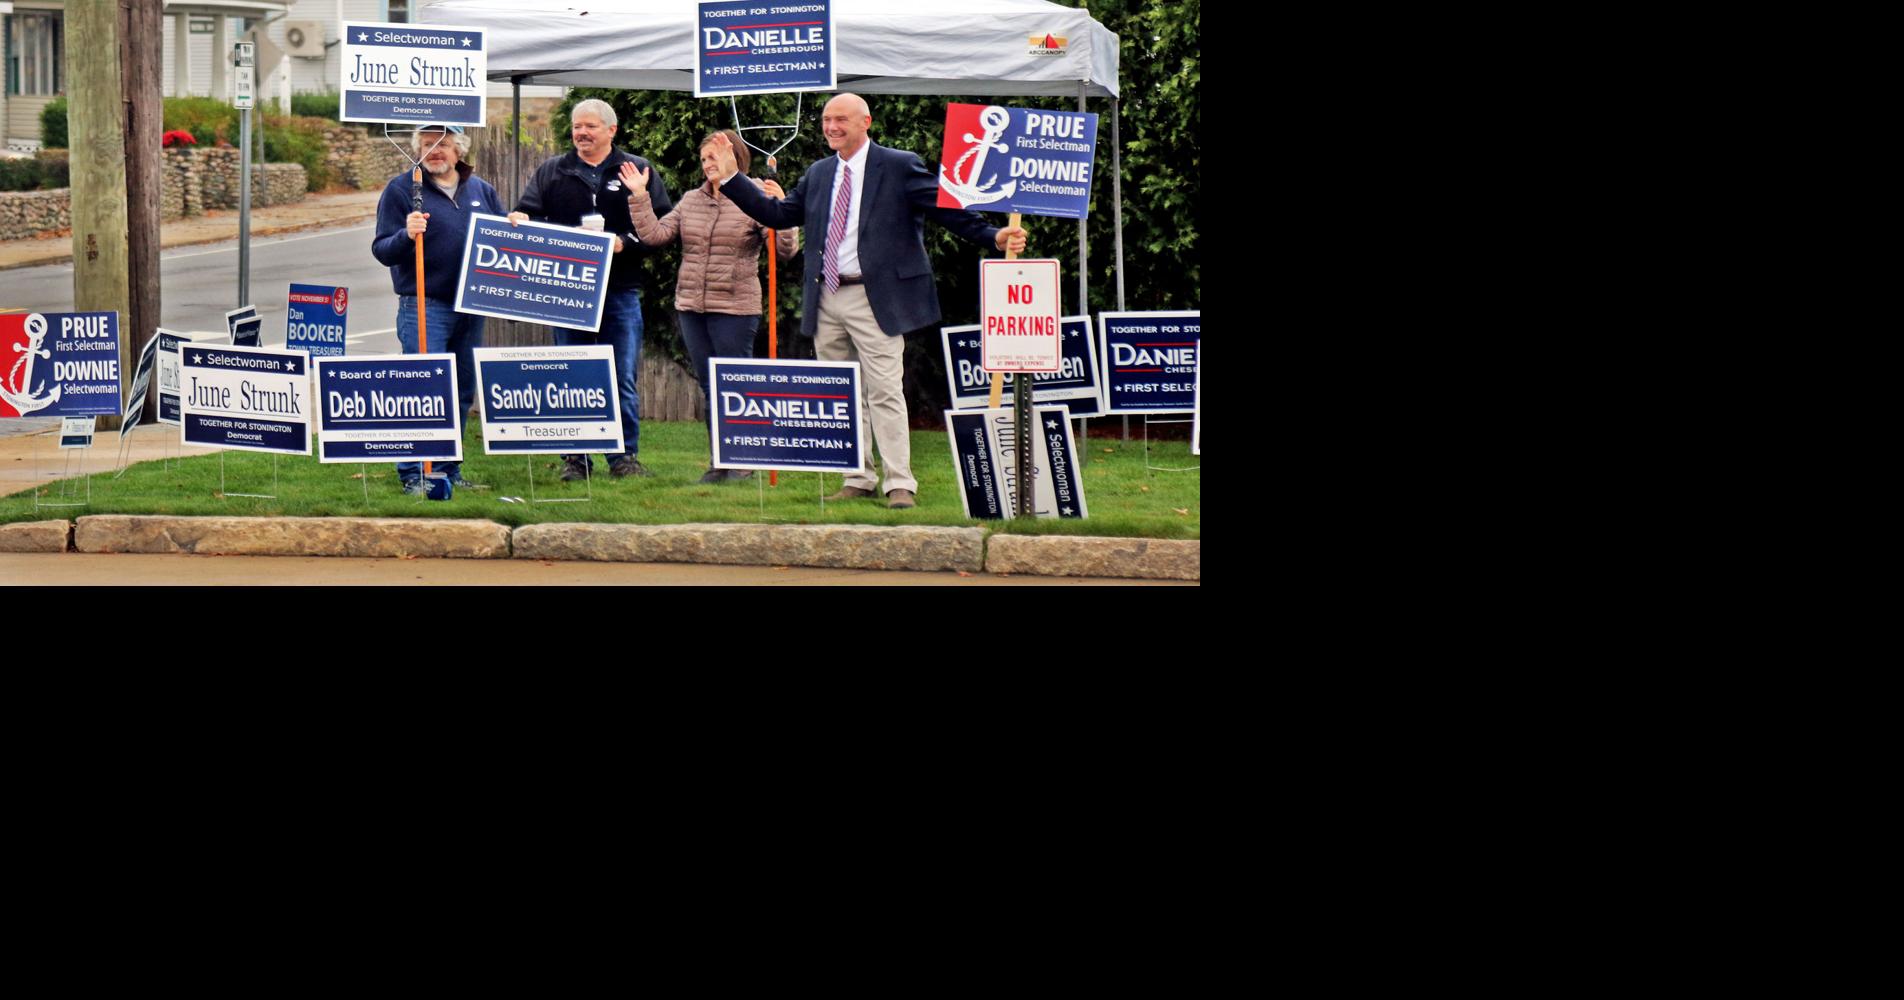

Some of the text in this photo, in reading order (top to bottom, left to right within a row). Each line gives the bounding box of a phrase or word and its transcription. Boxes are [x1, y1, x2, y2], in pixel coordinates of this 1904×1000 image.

[704, 10, 747, 18] TOGETHER
[771, 5, 825, 14] STONINGTON
[374, 32, 455, 46] Selectwoman
[703, 27, 824, 49] DANIELLE
[751, 45, 824, 54] CHESEBROUGH
[351, 54, 476, 88] June Strunk
[713, 62, 817, 75] FIRST SELECTMAN
[362, 95, 465, 106] TOGETHER FOR STONINGTON
[393, 106, 432, 115] Democrat
[1026, 113, 1085, 139] PRUE
[1016, 136, 1090, 153] First Selectman
[1009, 156, 1090, 183] DOWNIE
[1020, 181, 1086, 196] Selectwoman
[480, 227, 604, 253] TOGETHER FOR STONINGTON
[475, 243, 598, 283] DANIELLE
[521, 275, 595, 291] CHESEBROUGH
[479, 285, 585, 309] FIRST SELECTMAN
[1007, 284, 1033, 305] NO
[289, 308, 304, 320] Dan
[61, 316, 109, 338] PRUE
[288, 322, 343, 342] BOOKER
[987, 315, 1054, 336] PARKING
[56, 341, 115, 351] First Selectman
[308, 346, 343, 356] TREASURER
[207, 353, 280, 370] Selectwoman
[1110, 343, 1195, 366] DANIE
[53, 360, 119, 381] DOWNIE
[340, 370, 431, 379] Board of Finance
[521, 362, 569, 371] Democrat
[721, 373, 850, 385] TOGETHER FOR STONINGTON
[64, 383, 118, 395] Selectwoman
[188, 376, 231, 409] June
[241, 380, 301, 414] Strunk
[1035, 391, 1074, 399] TONINGTON
[1124, 383, 1196, 393] FIRST SELEC
[329, 390, 446, 418] Deb Norman
[491, 382, 607, 415] Sandy Grimes
[720, 391, 850, 420] DANIELLE
[199, 418, 292, 433] TOGETHER FOR STONINGTON
[522, 425, 581, 437] Treasurer
[772, 420, 850, 429] CHESEBROUGH
[227, 431, 262, 440] Democrat
[733, 436, 843, 449] FIRST SELECTMAN
[364, 442, 414, 450] Democrat
[966, 454, 980, 487] Democrat
[974, 427, 998, 514] TOGETHER FOR STONINGTON
[1049, 434, 1072, 502] Selectwoman
